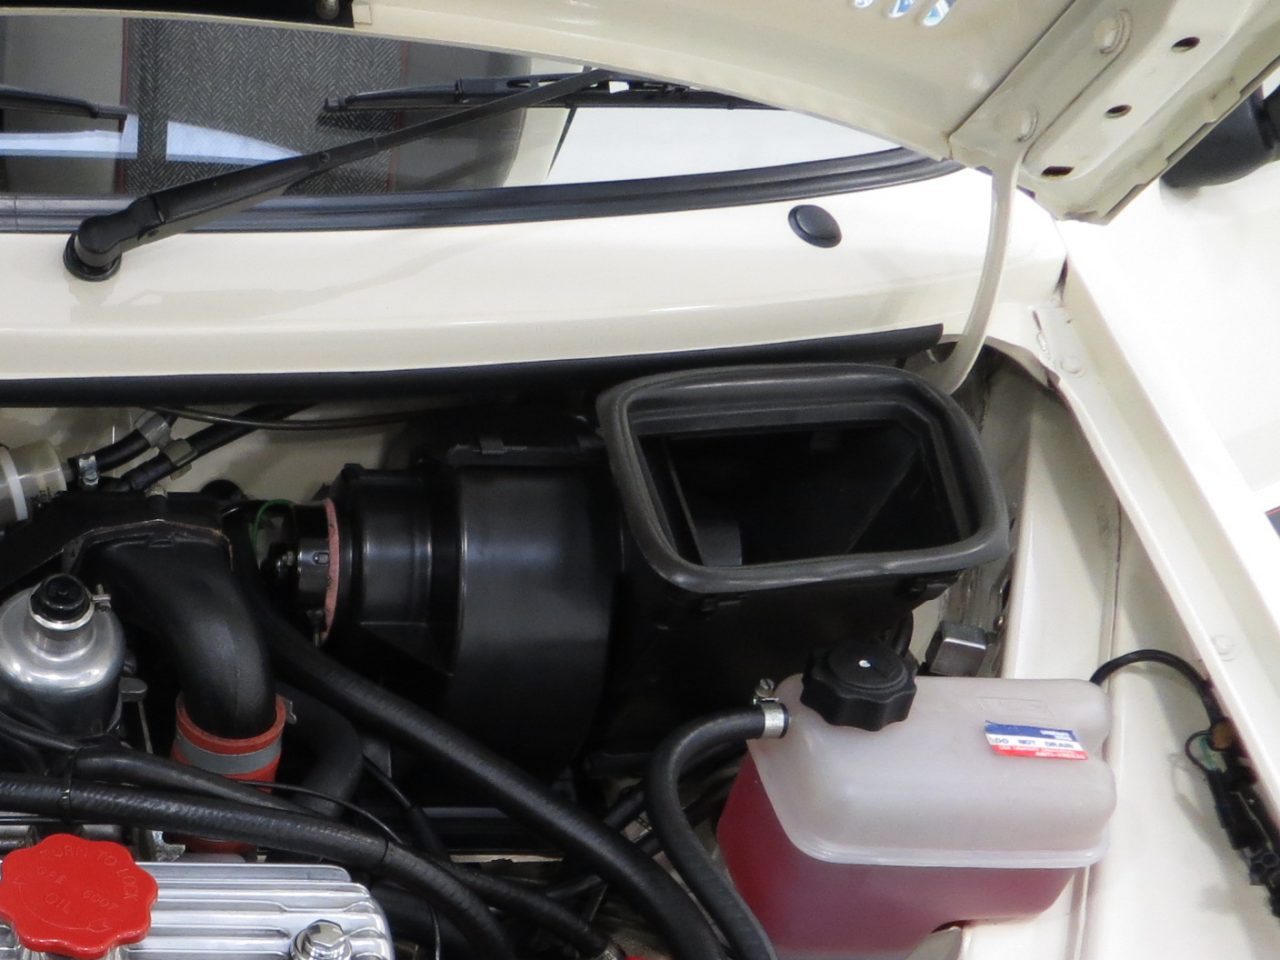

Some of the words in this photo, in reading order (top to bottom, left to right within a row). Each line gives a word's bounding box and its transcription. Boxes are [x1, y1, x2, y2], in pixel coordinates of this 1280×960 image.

[96, 849, 118, 867] TO
[116, 868, 139, 903] LOCK
[44, 892, 73, 915] OIL
